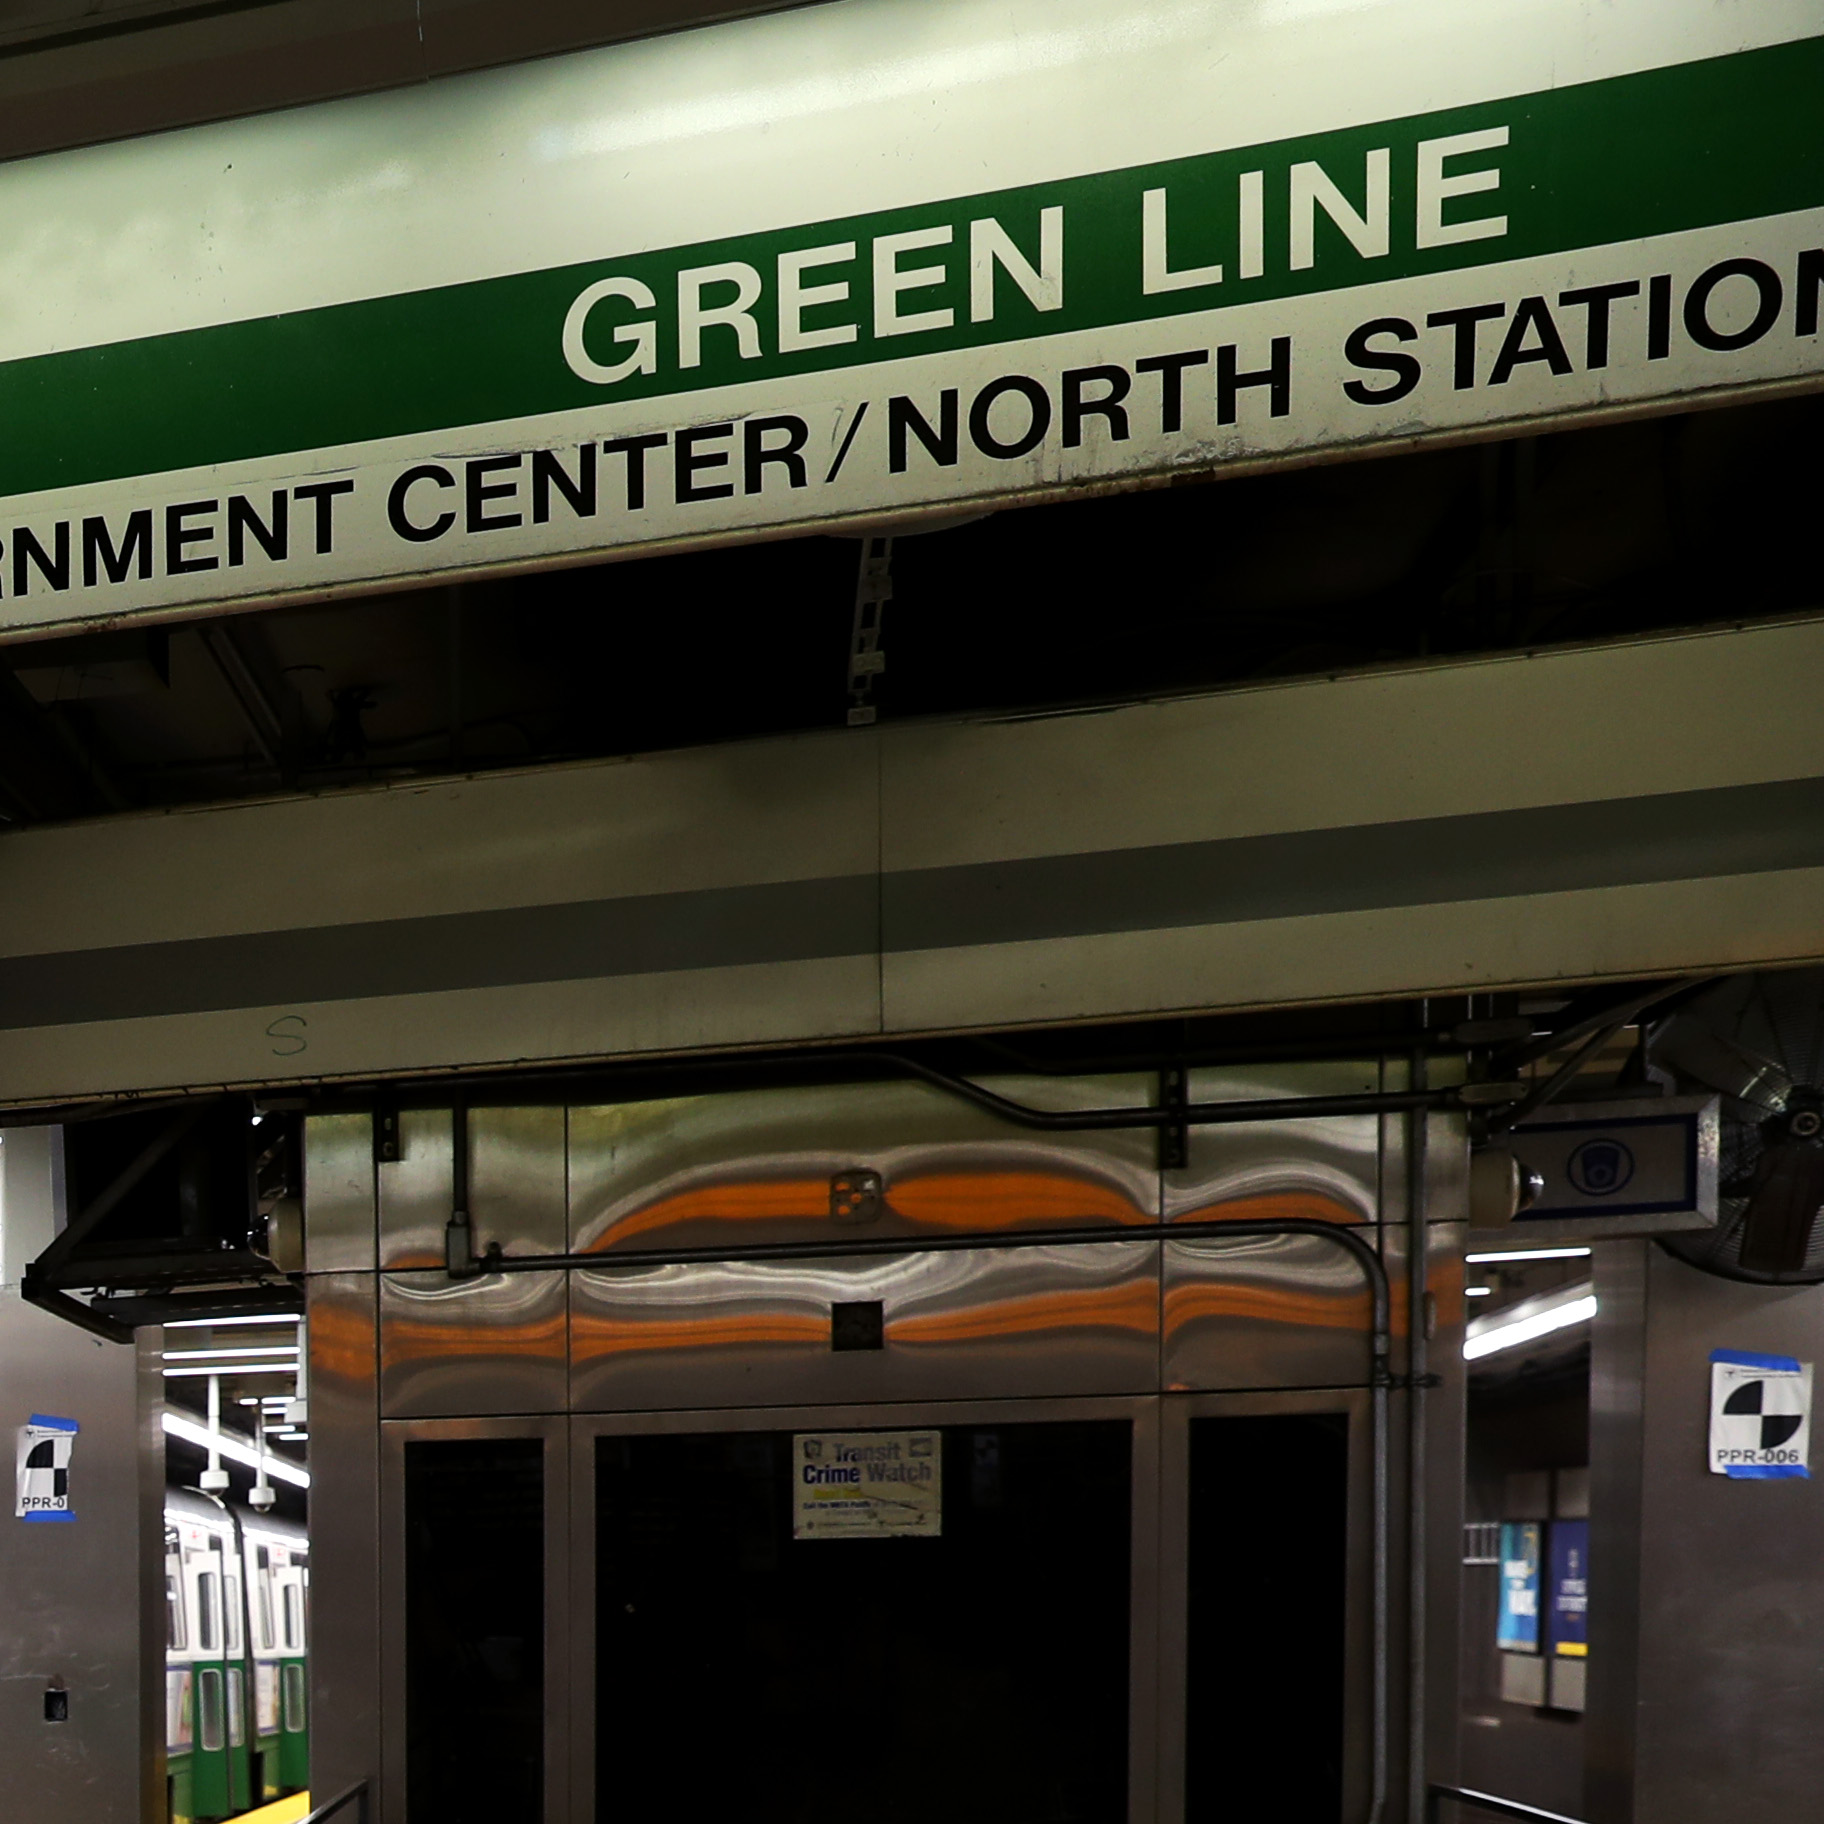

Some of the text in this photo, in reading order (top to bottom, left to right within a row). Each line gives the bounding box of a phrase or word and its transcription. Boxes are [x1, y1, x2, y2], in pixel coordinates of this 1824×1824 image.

[562, 125, 1510, 385] GREEN LINE
[833, 1441, 901, 1462] Transit
[1717, 1448, 1799, 1464] PPR-006
[803, 1461, 931, 1484] Crime Watch
